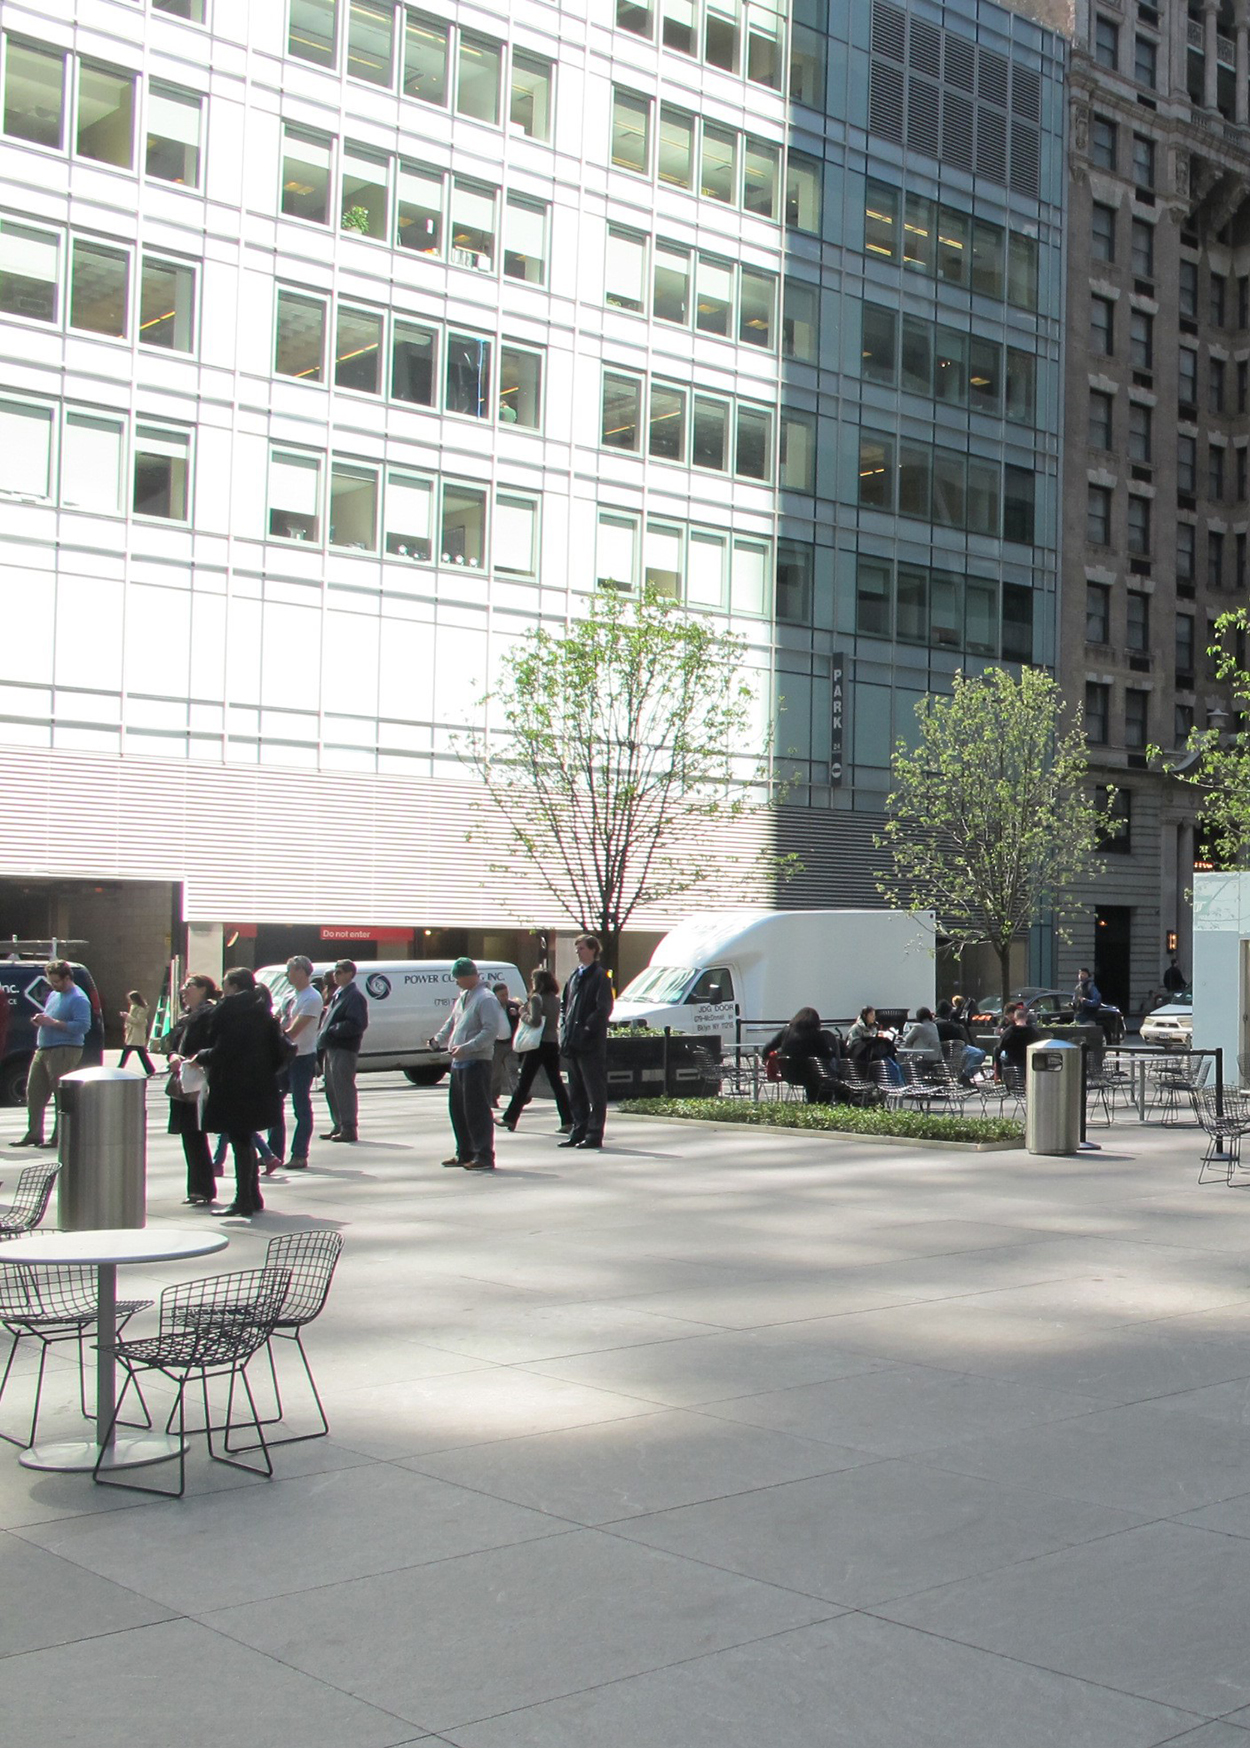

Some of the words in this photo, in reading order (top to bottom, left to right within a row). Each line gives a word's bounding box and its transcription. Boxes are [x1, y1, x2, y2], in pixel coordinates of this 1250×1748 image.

[833, 669, 842, 729] PARK
[323, 929, 334, 938] Do
[336, 930, 349, 938] not
[349, 930, 371, 938] enter
[404, 974, 439, 984] POWER
[487, 972, 505, 981] INC.
[714, 1003, 734, 1012] DOOR
